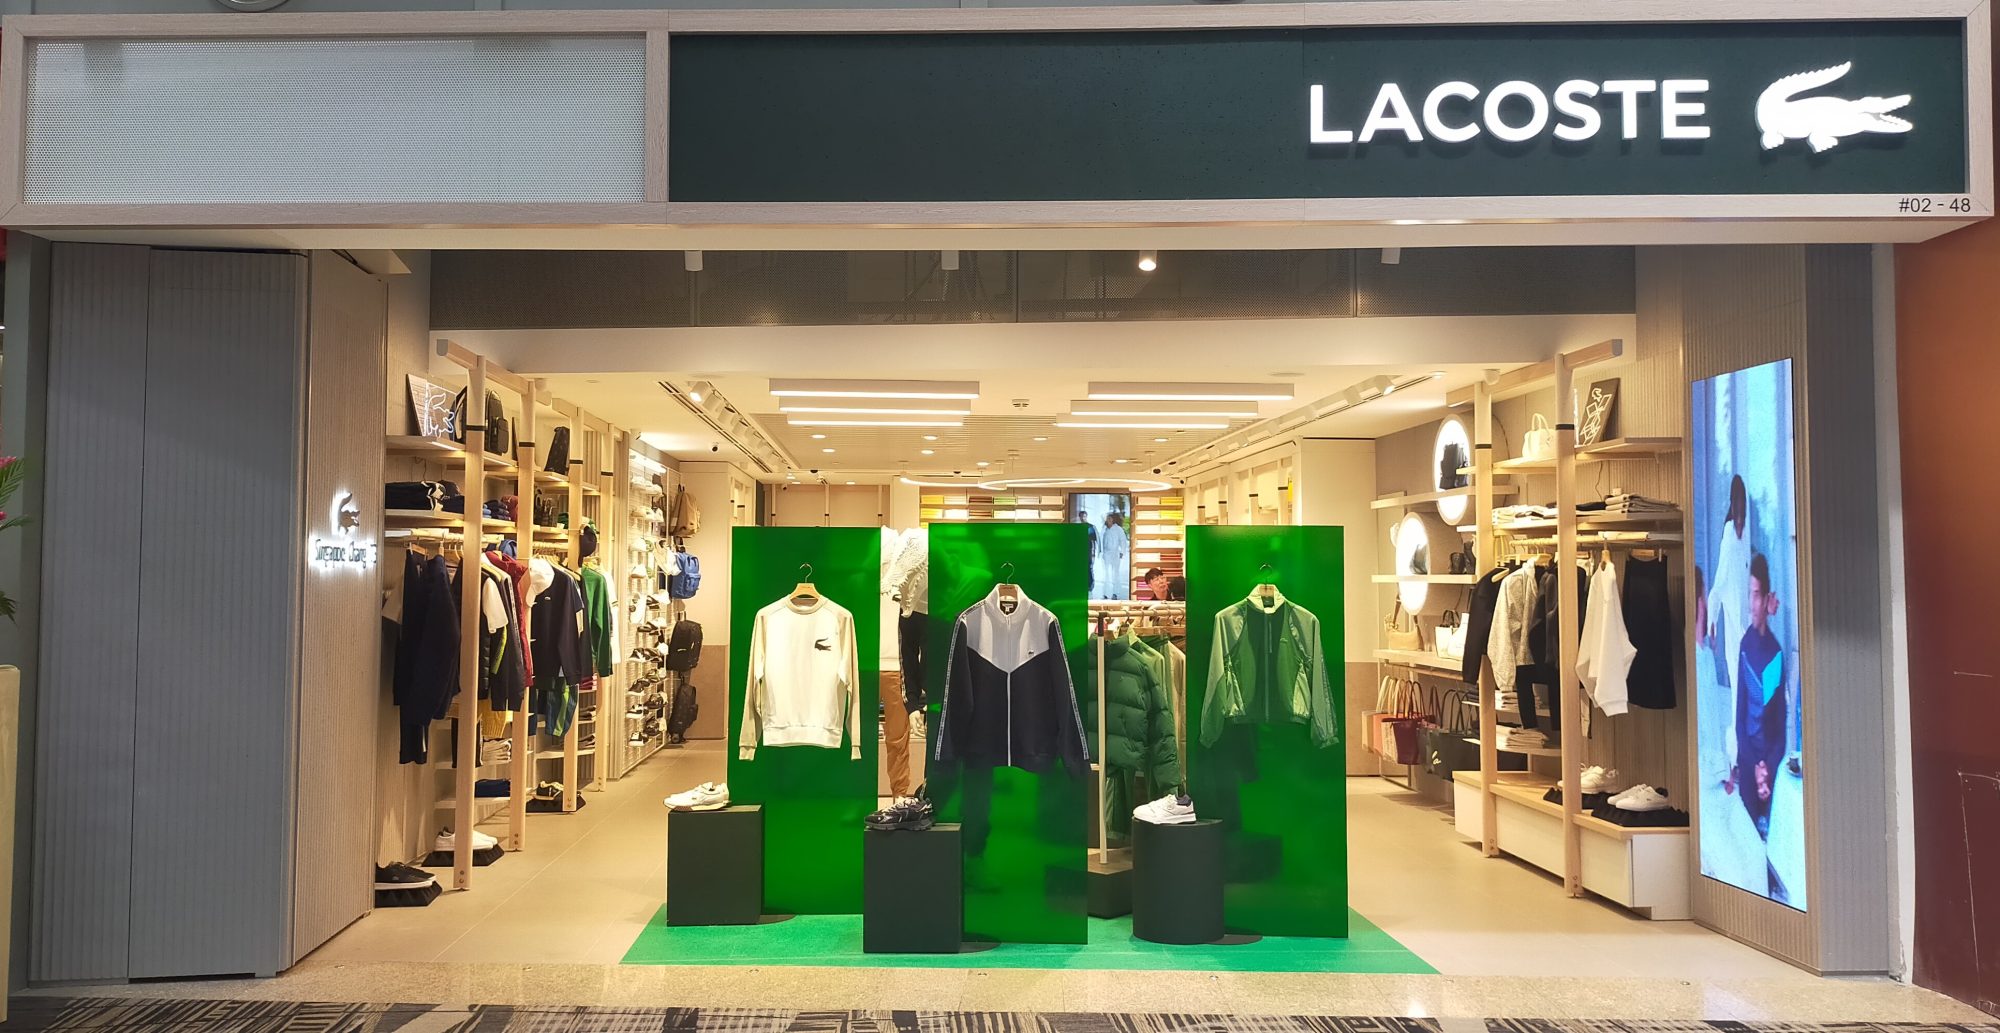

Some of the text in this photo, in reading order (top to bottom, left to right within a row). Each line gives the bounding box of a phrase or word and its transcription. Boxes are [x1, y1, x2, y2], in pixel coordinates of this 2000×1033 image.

[1310, 79, 1711, 143] LACOSTE
[1899, 198, 1931, 213] #02
[1949, 198, 1971, 212] 48
